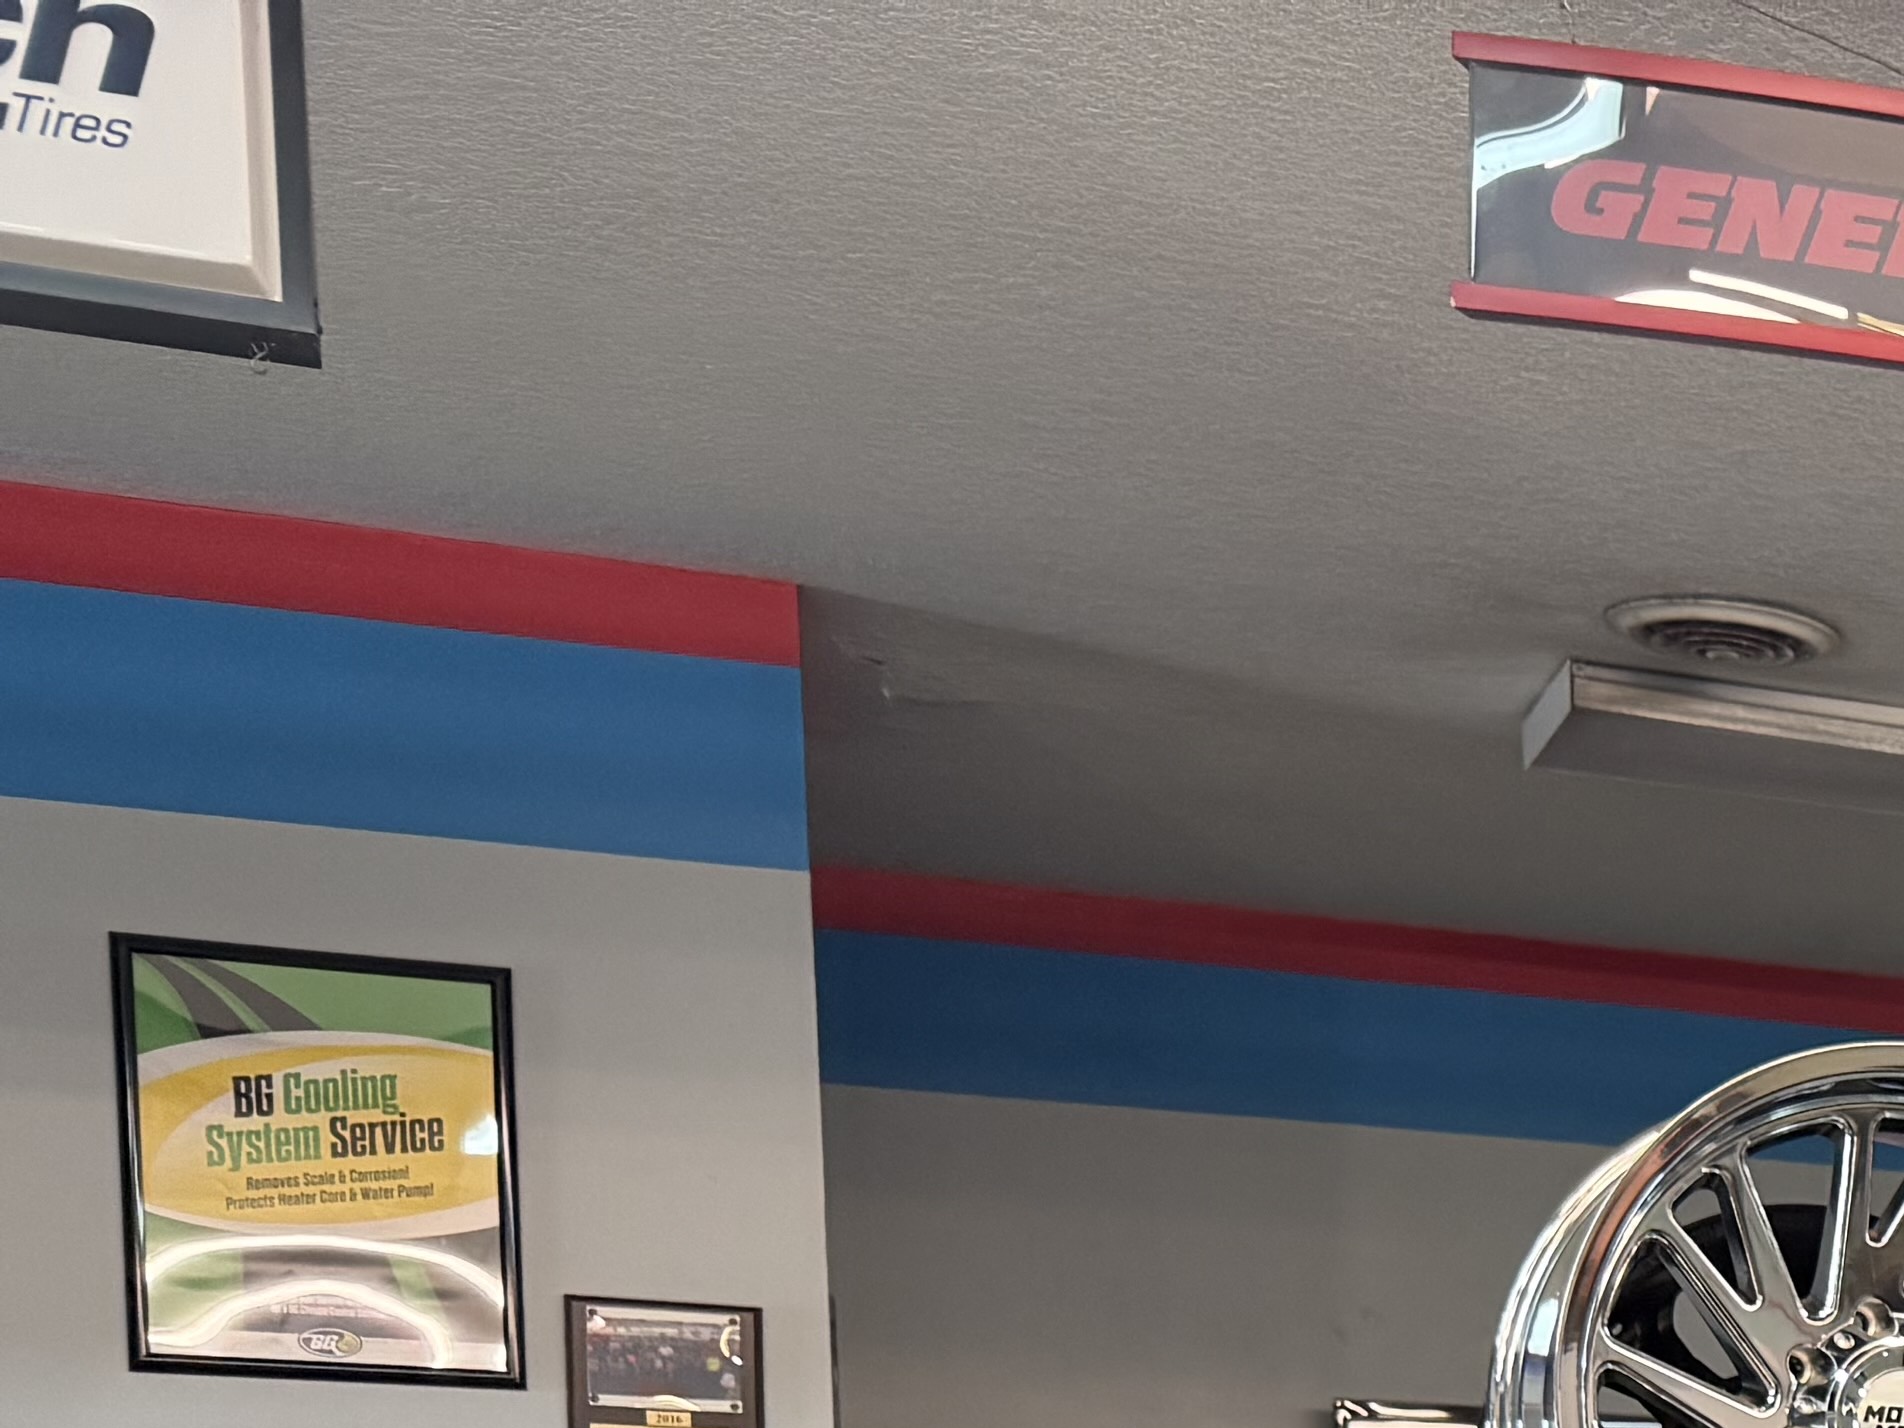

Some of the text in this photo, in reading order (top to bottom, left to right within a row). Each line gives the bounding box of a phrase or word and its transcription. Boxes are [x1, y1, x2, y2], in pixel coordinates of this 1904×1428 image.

[12, 91, 132, 148] Tires
[232, 1068, 400, 1118] BG Cooling
[205, 1112, 445, 1172] System Service
[225, 1195, 275, 1211] Protects
[278, 1191, 317, 1206] Heater
[319, 1189, 347, 1204] Core
[360, 1184, 395, 1201] Water
[246, 1175, 300, 1191] Removes
[303, 1171, 336, 1187] Scale
[656, 1413, 684, 1425] 2016
